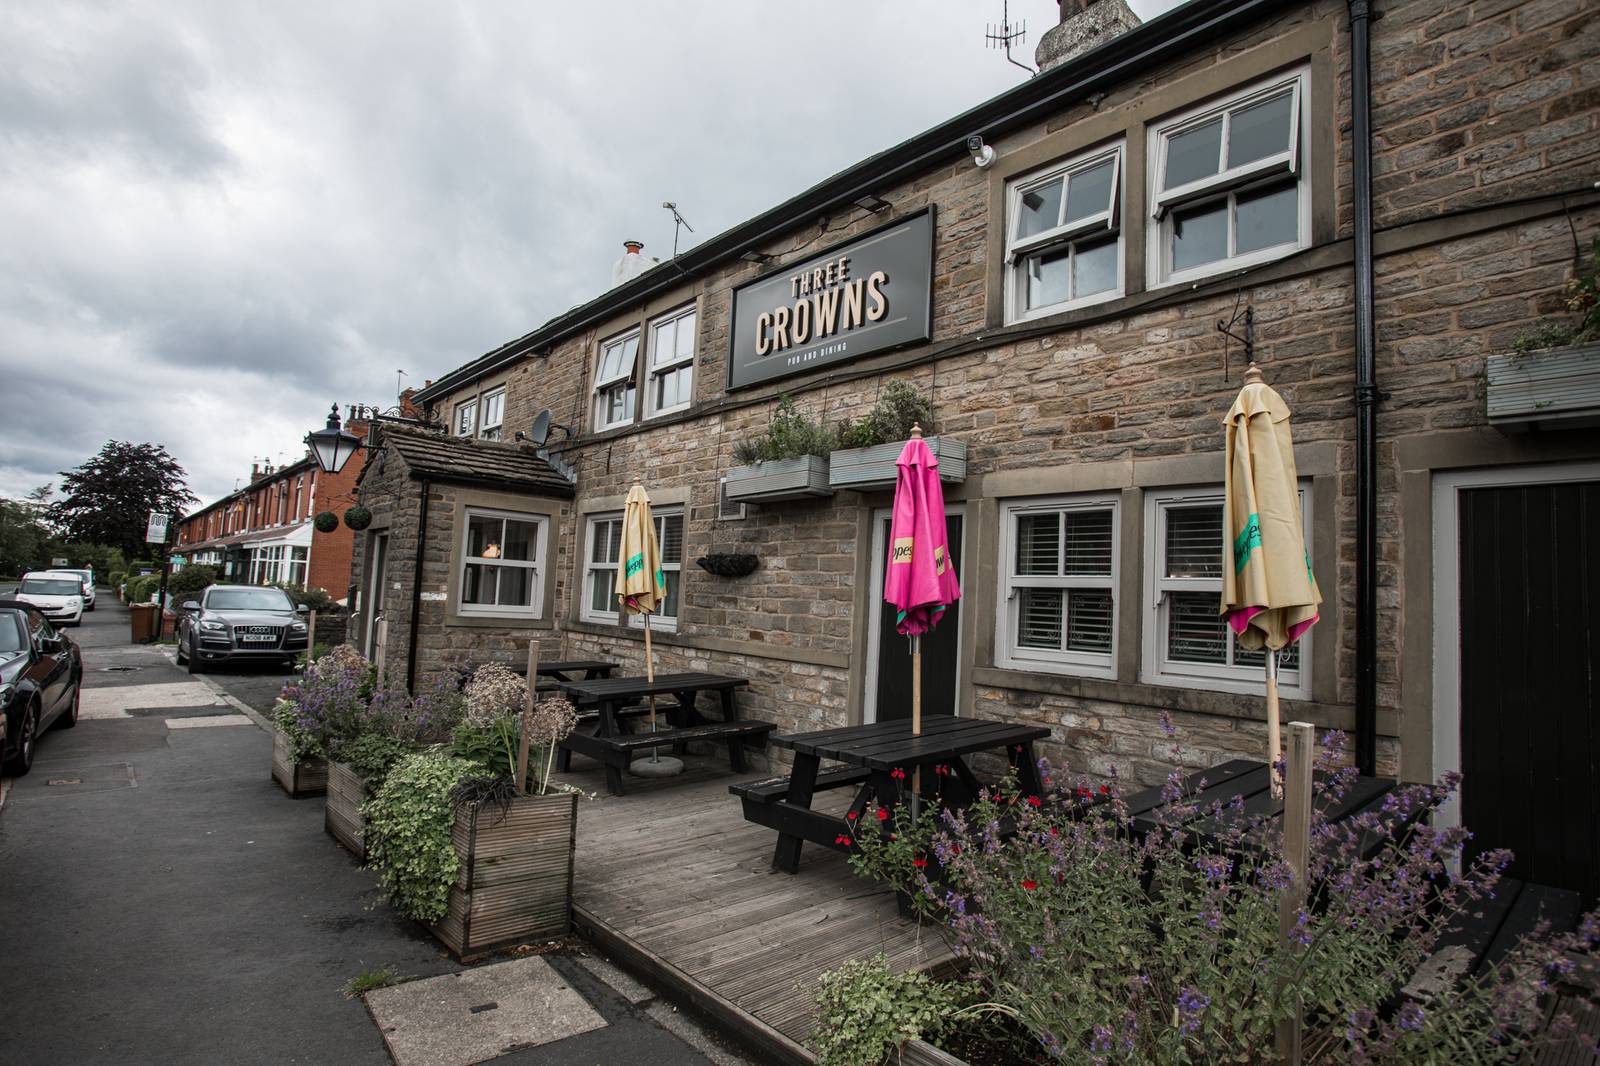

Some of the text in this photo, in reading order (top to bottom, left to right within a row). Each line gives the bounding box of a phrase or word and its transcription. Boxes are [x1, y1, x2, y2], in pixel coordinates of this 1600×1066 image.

[790, 256, 849, 298] THREE
[755, 270, 889, 356] CROWNS
[787, 342, 847, 367] PUB AND DINING
